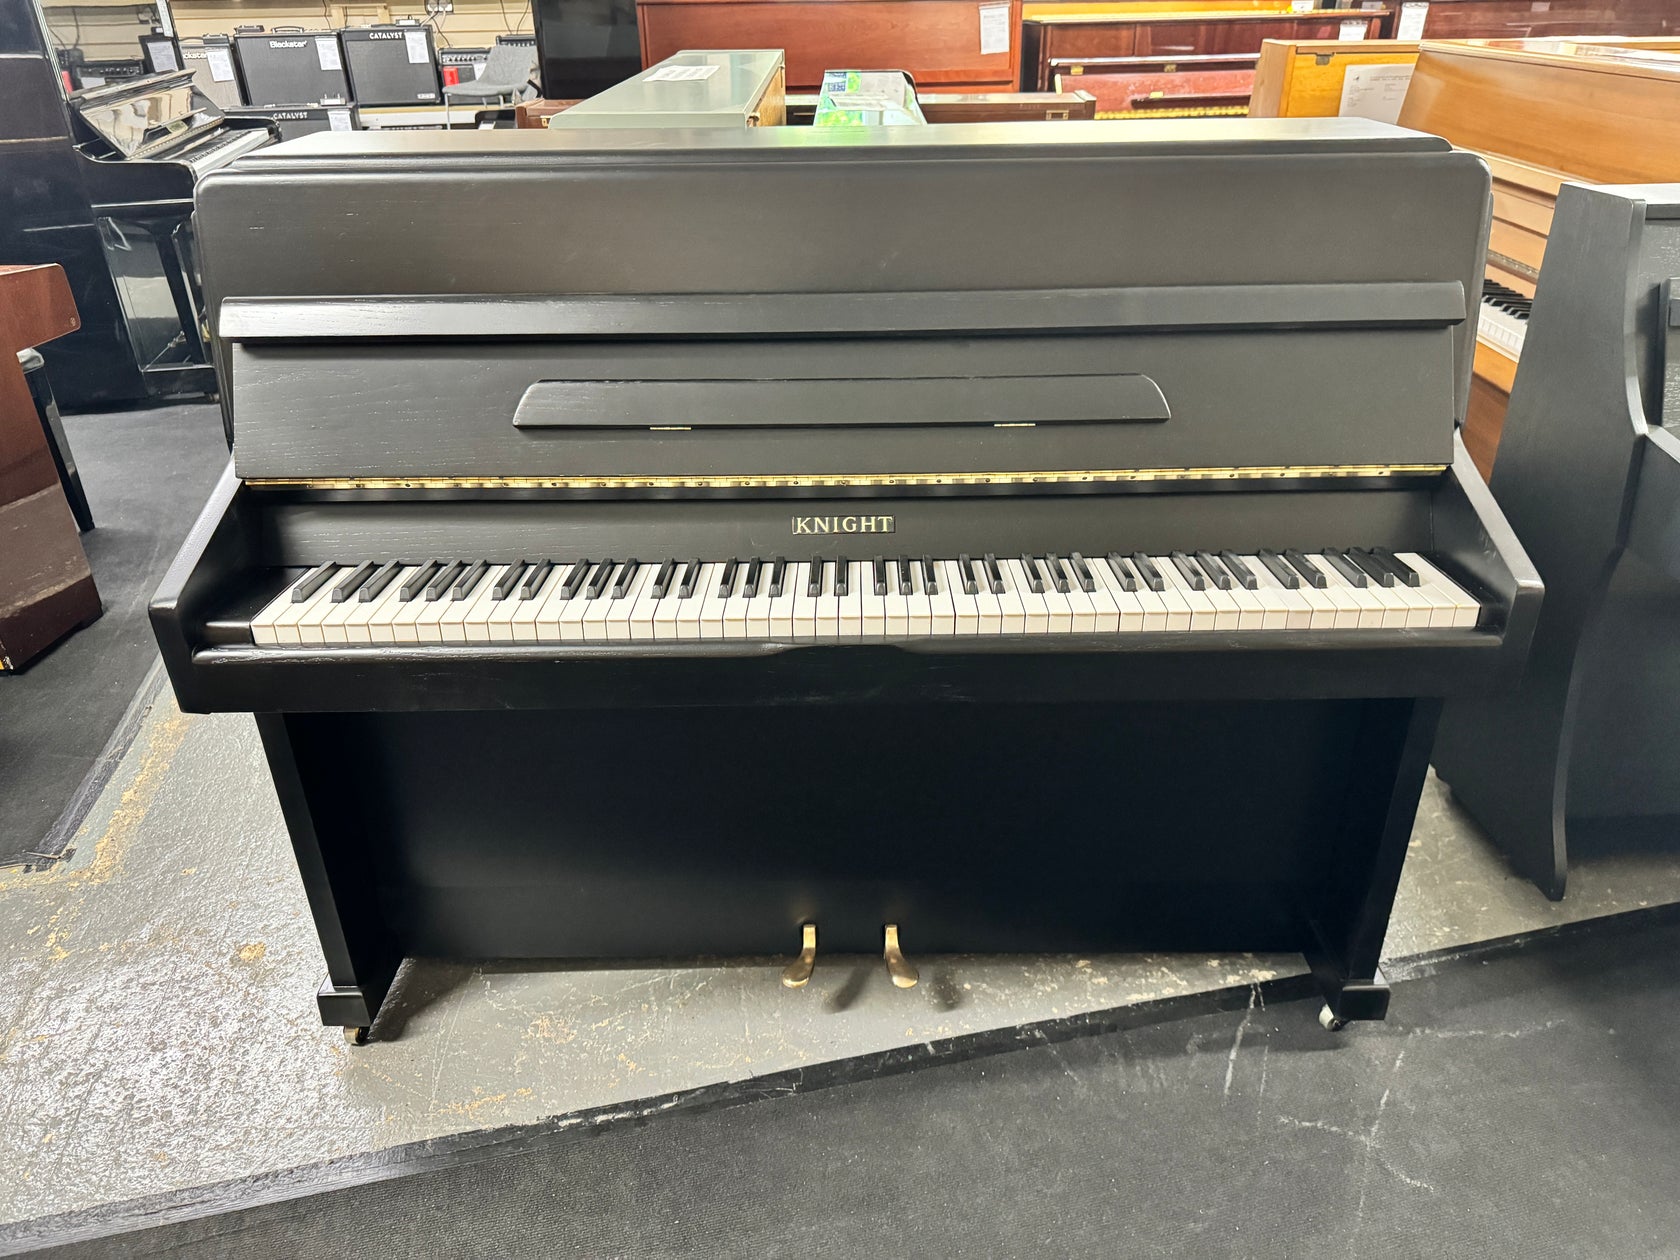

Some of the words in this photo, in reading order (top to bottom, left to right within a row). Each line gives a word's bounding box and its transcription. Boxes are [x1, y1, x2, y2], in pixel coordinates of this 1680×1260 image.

[369, 31, 403, 40] CATALYST
[269, 40, 308, 49] Blackstar
[272, 111, 308, 121] CATALYST
[796, 516, 893, 533] KNIGHT
